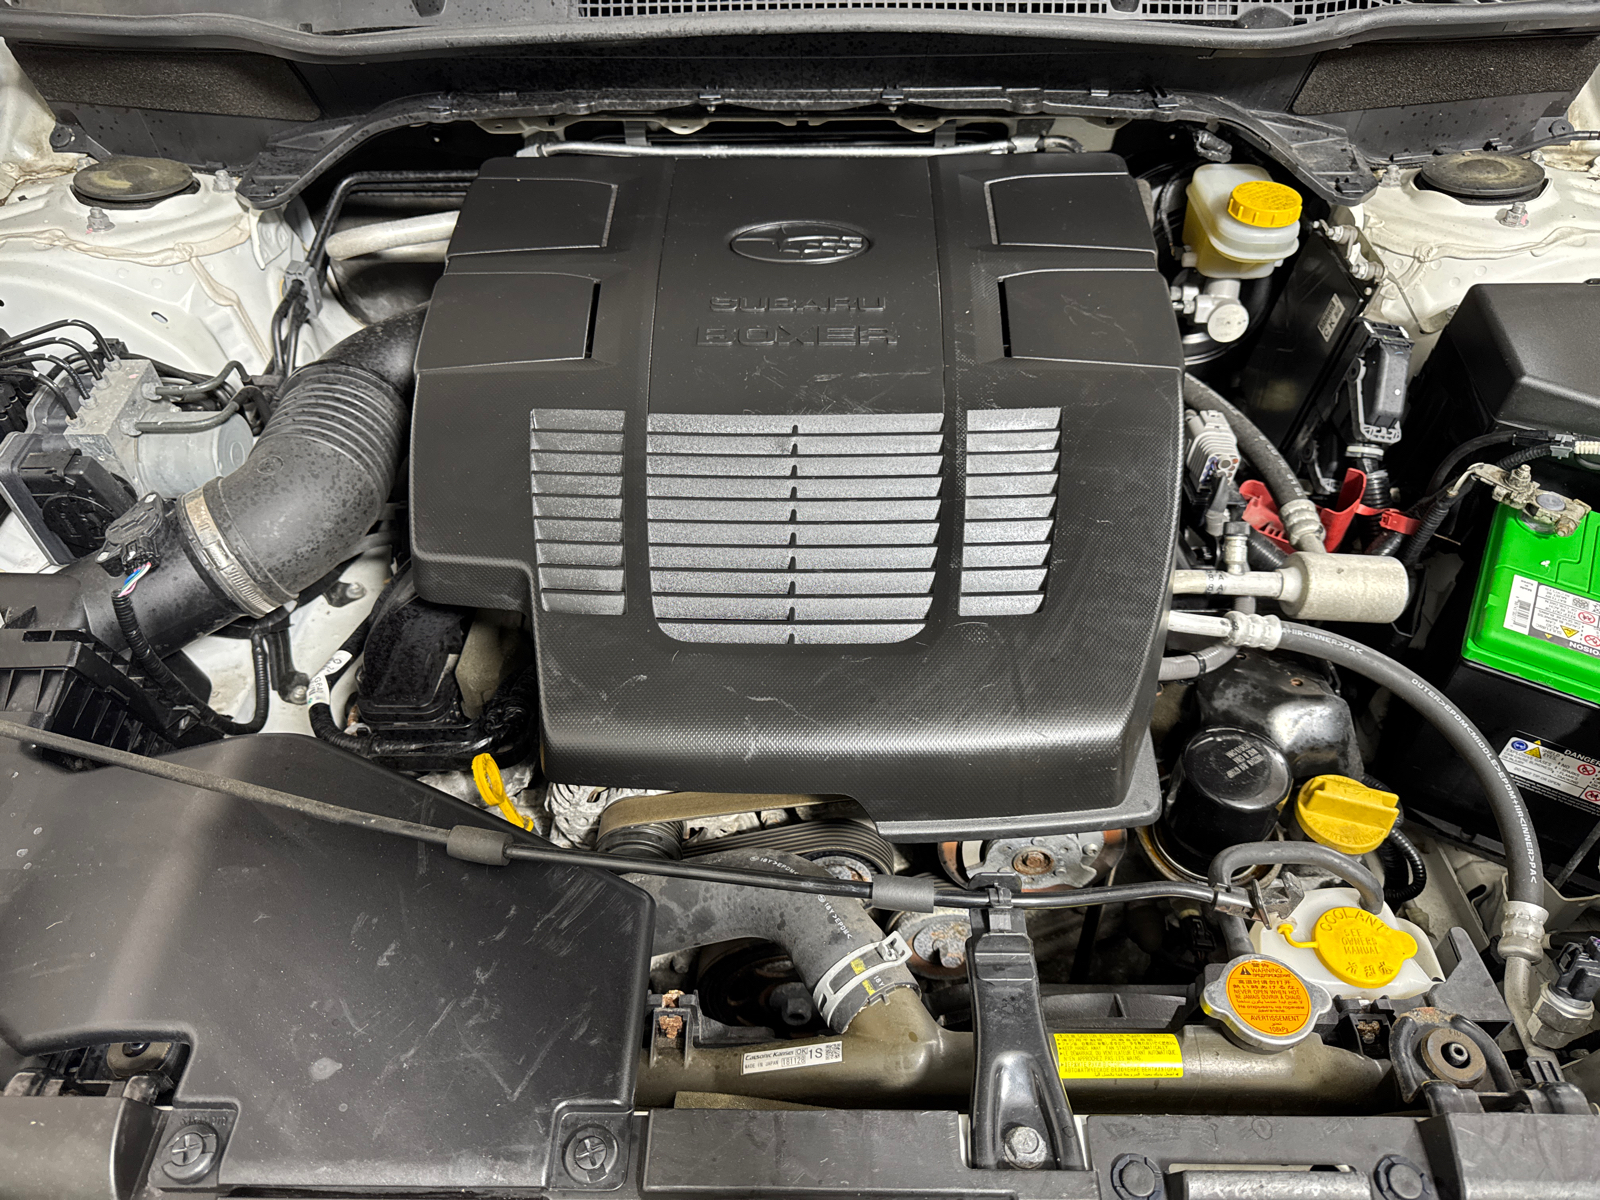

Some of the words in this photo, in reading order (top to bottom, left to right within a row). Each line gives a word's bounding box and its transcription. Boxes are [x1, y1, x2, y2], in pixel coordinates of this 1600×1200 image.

[710, 297, 886, 312] SUBARU
[696, 325, 898, 346] BOXER
[1320, 908, 1387, 931] COOLANT
[809, 1048, 823, 1059] 1S
